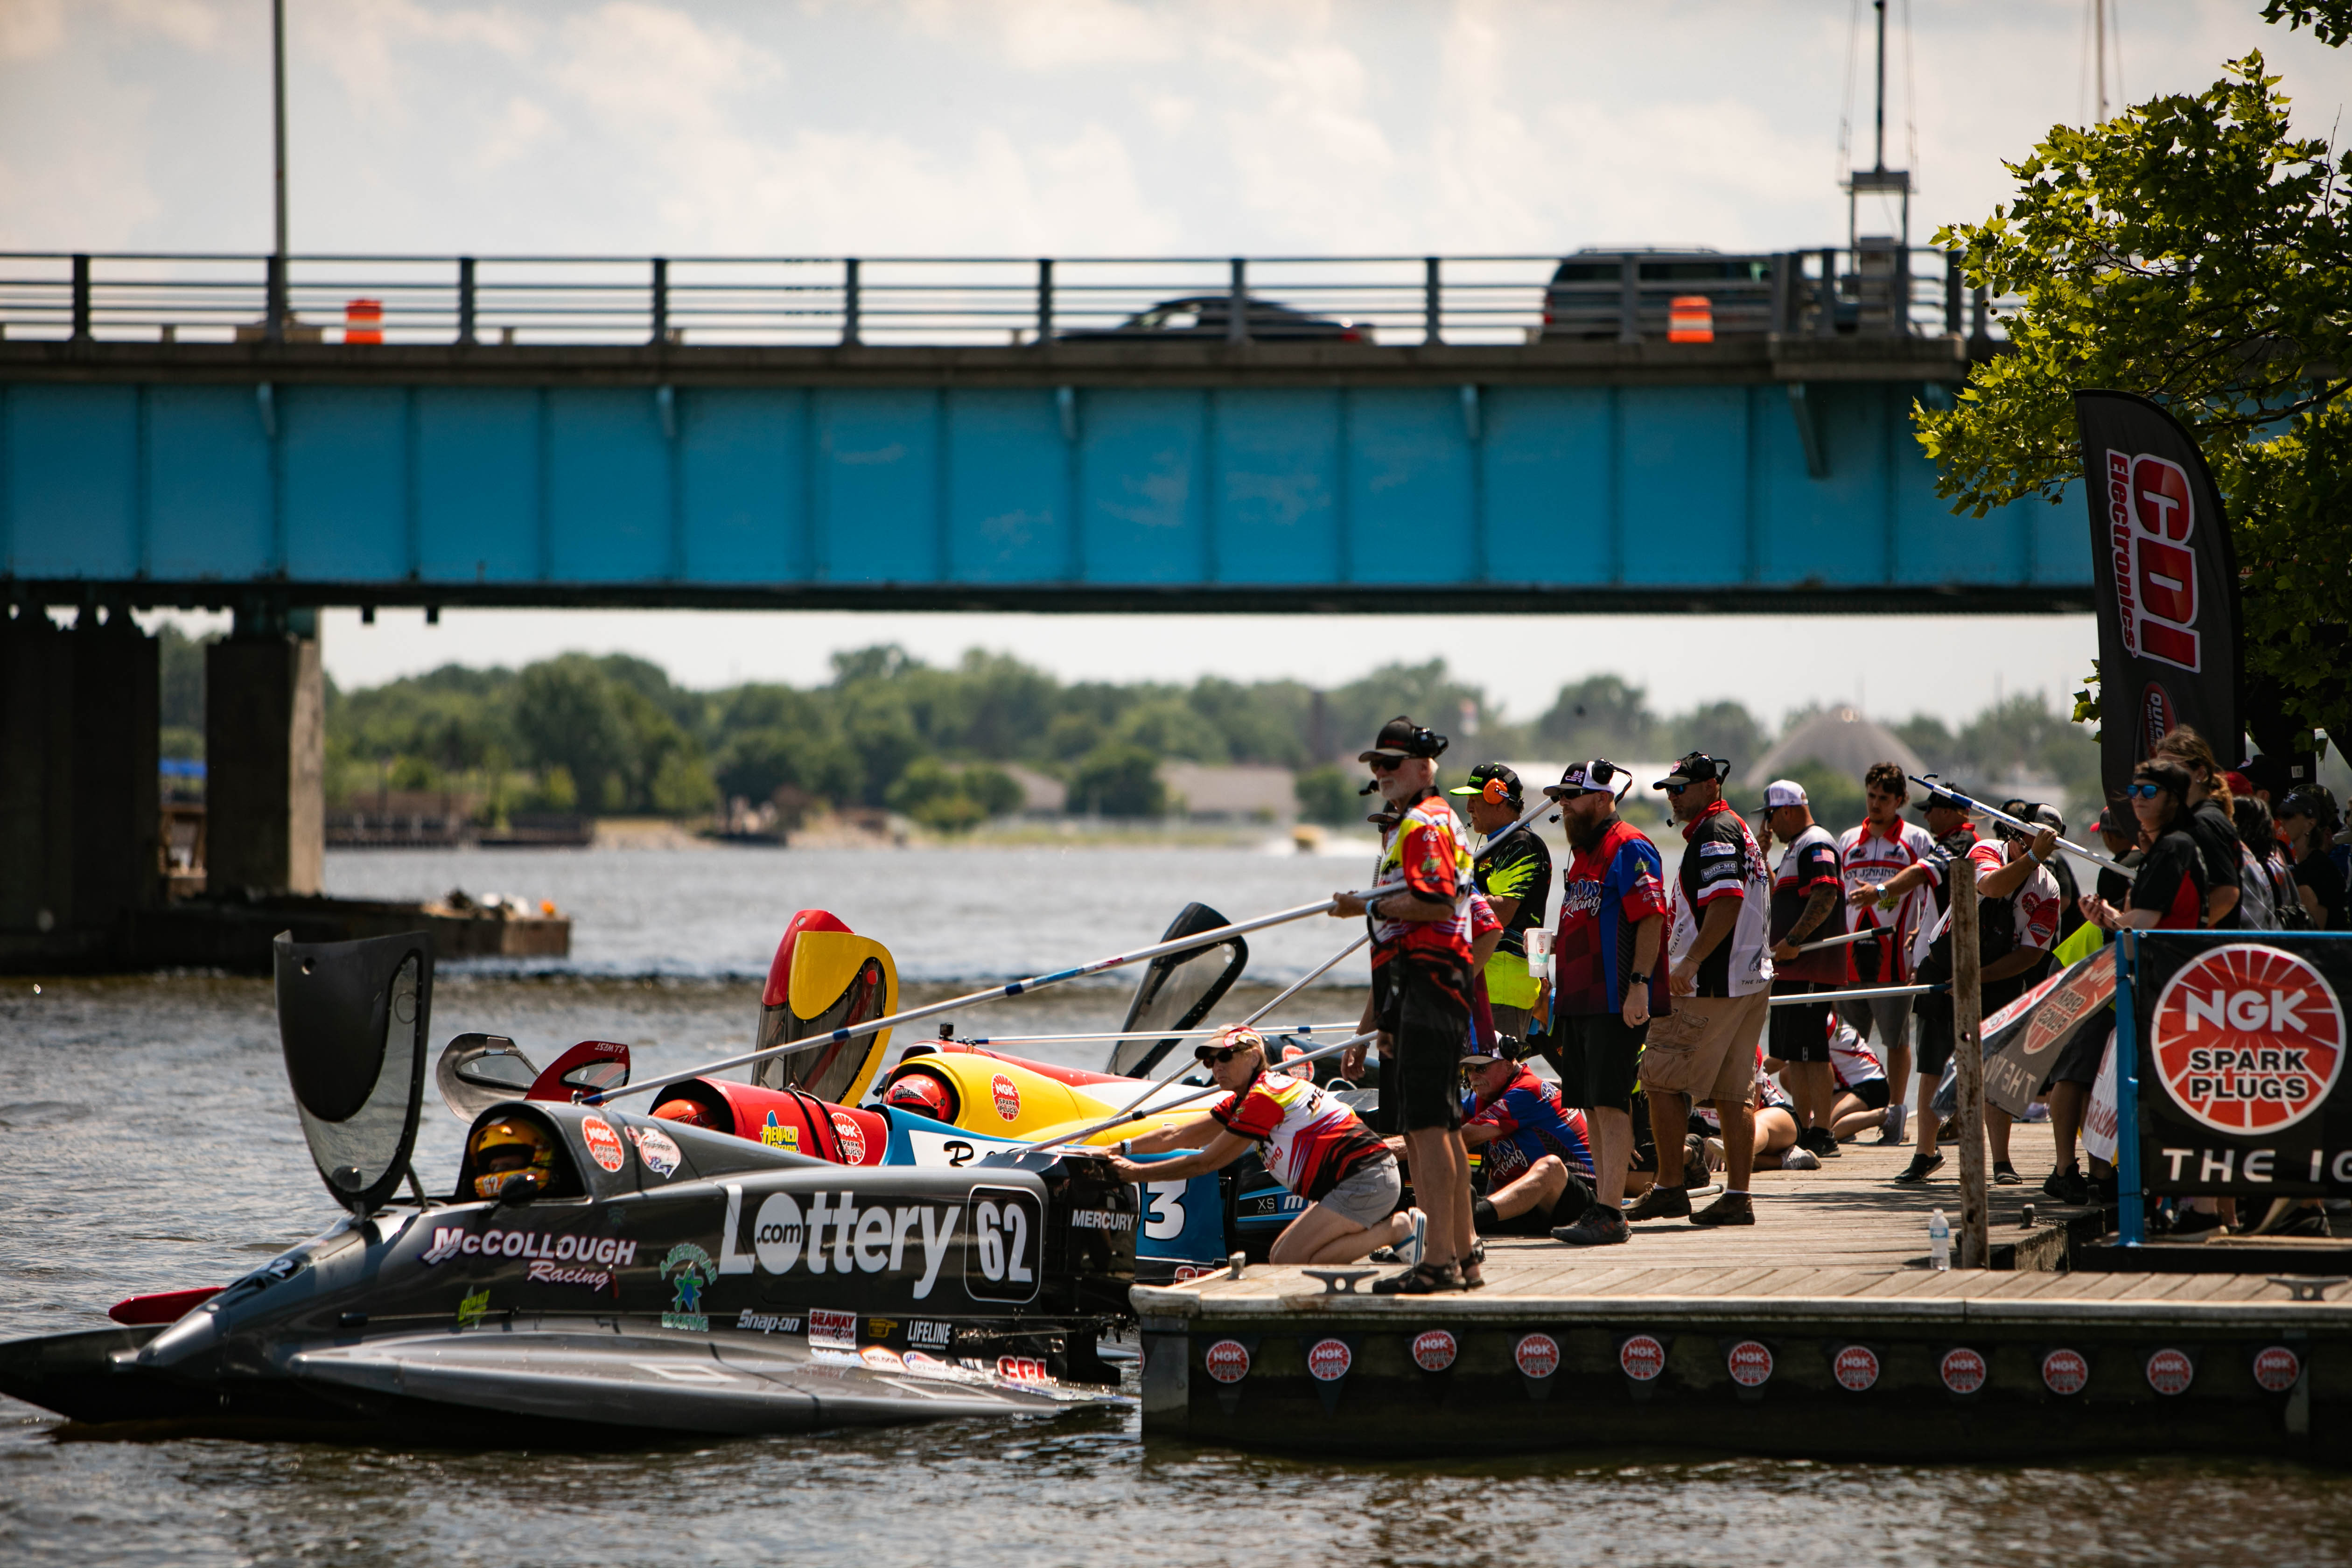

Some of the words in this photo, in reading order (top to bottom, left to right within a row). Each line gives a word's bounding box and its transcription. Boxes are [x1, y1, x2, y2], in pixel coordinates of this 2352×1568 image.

[2108, 451, 2135, 649] Electronics
[2134, 455, 2199, 671] CDI
[2150, 693, 2165, 739] QUIC
[1703, 864, 1736, 877] MOTO-MG
[1669, 922, 1684, 956] ECIALIST
[2186, 989, 2309, 1033] NGK
[595, 1043, 615, 1053] WEST
[2191, 1049, 2308, 1072] SPARK
[995, 1083, 1015, 1097] NGK
[2191, 1077, 2306, 1099] PLUGS
[999, 1106, 1016, 1114] PLUGS
[587, 1127, 614, 1142] NGK
[763, 1126, 798, 1145] DEWALD
[597, 1154, 620, 1163] PLUGS
[2163, 1149, 2276, 1182] THE
[483, 1176, 498, 1195] 62
[1258, 1198, 1275, 1210] XS
[1072, 1209, 1134, 1232] MERCURY
[719, 1184, 961, 1300] Lottery
[756, 1219, 801, 1244] .com
[976, 1201, 1032, 1283] 62
[424, 1227, 637, 1266] McCOLLOUGH
[659, 1243, 717, 1286] AMERISTAR
[527, 1260, 610, 1292] Racing
[662, 1311, 709, 1332] ROOFING
[736, 1308, 800, 1335] Snap-on
[810, 1311, 855, 1329] SEAWAY
[810, 1326, 854, 1339] MARINECOM
[907, 1319, 952, 1344] LIFELINE
[1420, 1338, 1448, 1350] NGK
[1523, 1344, 1551, 1355] NGK
[1628, 1346, 1656, 1358] NGK
[1213, 1350, 1241, 1362] NGK
[1316, 1350, 1343, 1360] NGK
[1736, 1351, 1764, 1363] NGK
[1842, 1357, 1870, 1368] NGK
[997, 1355, 1048, 1379] CDI
